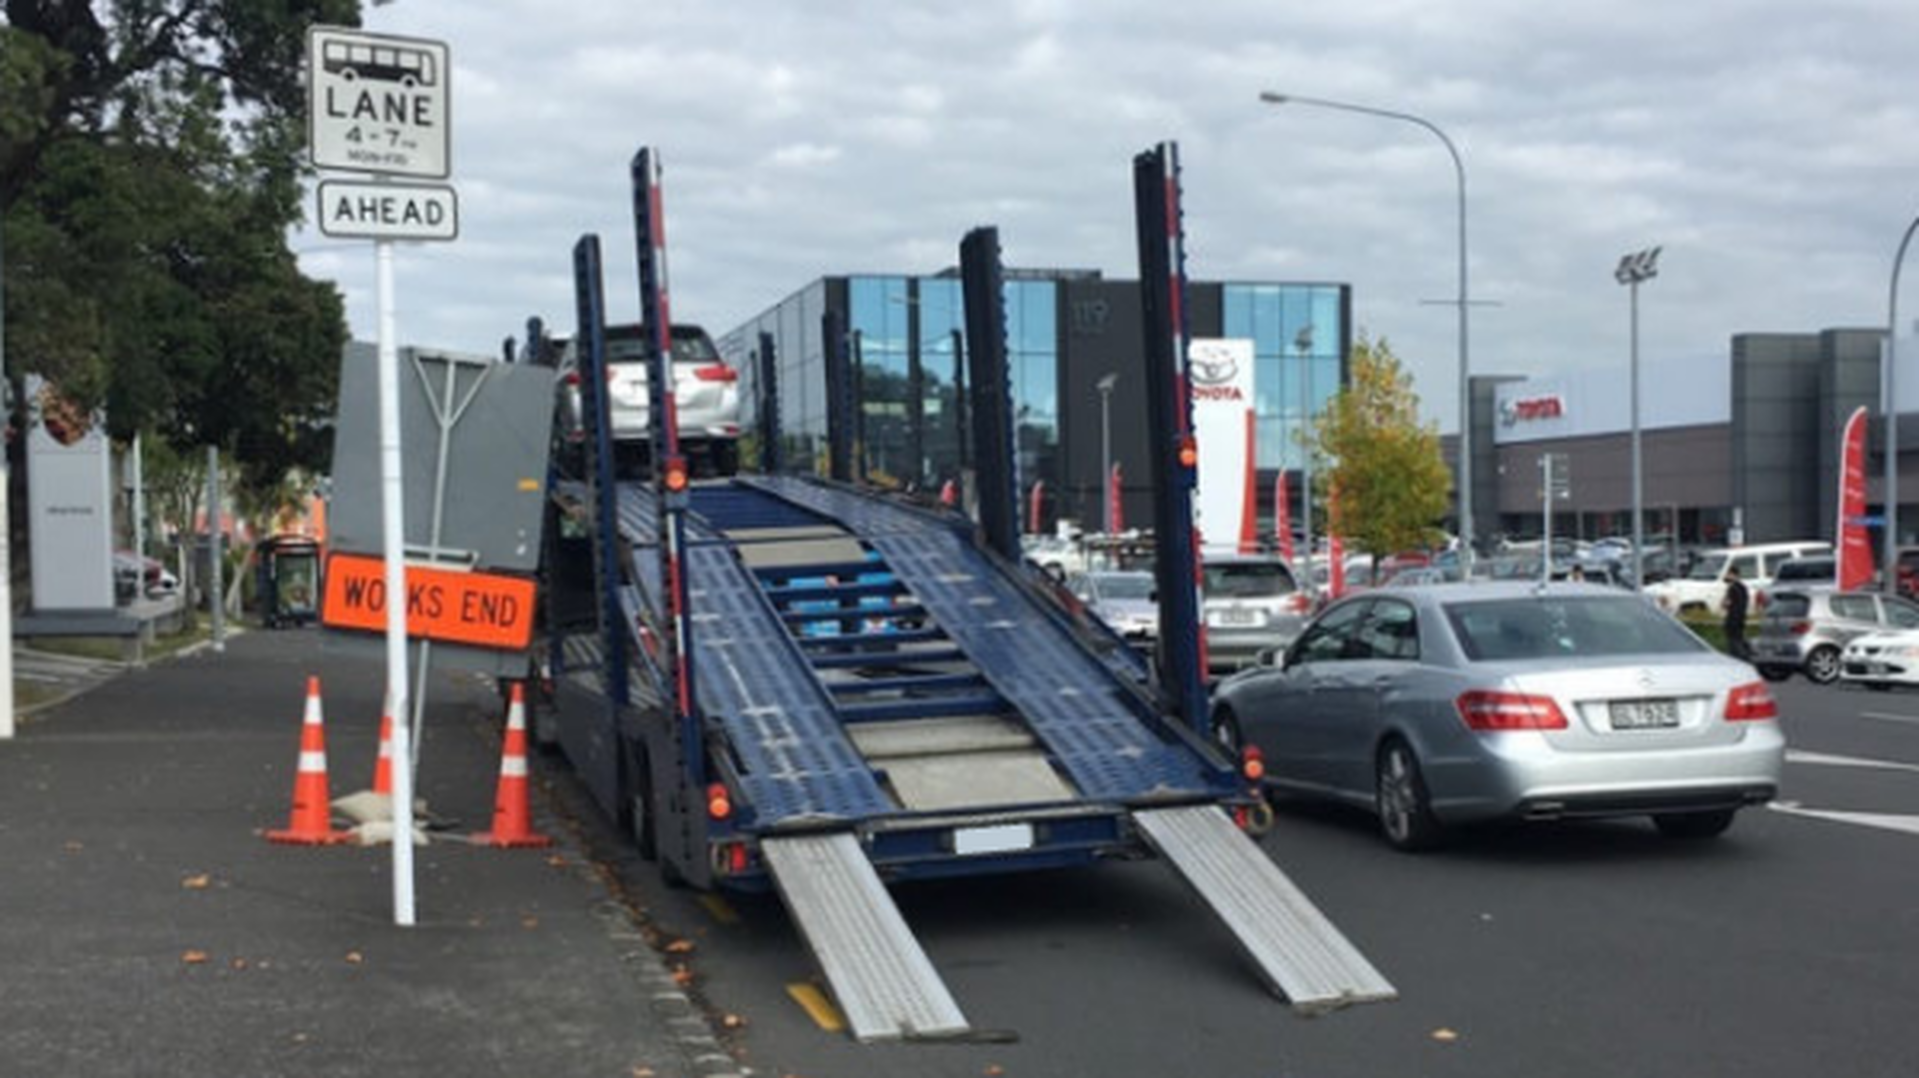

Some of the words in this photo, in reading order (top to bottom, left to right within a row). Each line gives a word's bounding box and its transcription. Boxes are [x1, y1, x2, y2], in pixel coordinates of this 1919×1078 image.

[326, 86, 434, 126] LANE
[334, 195, 444, 226] AHEAD
[1191, 386, 1243, 400] OYOTA
[344, 574, 444, 619] WOKS
[460, 589, 519, 627] END
